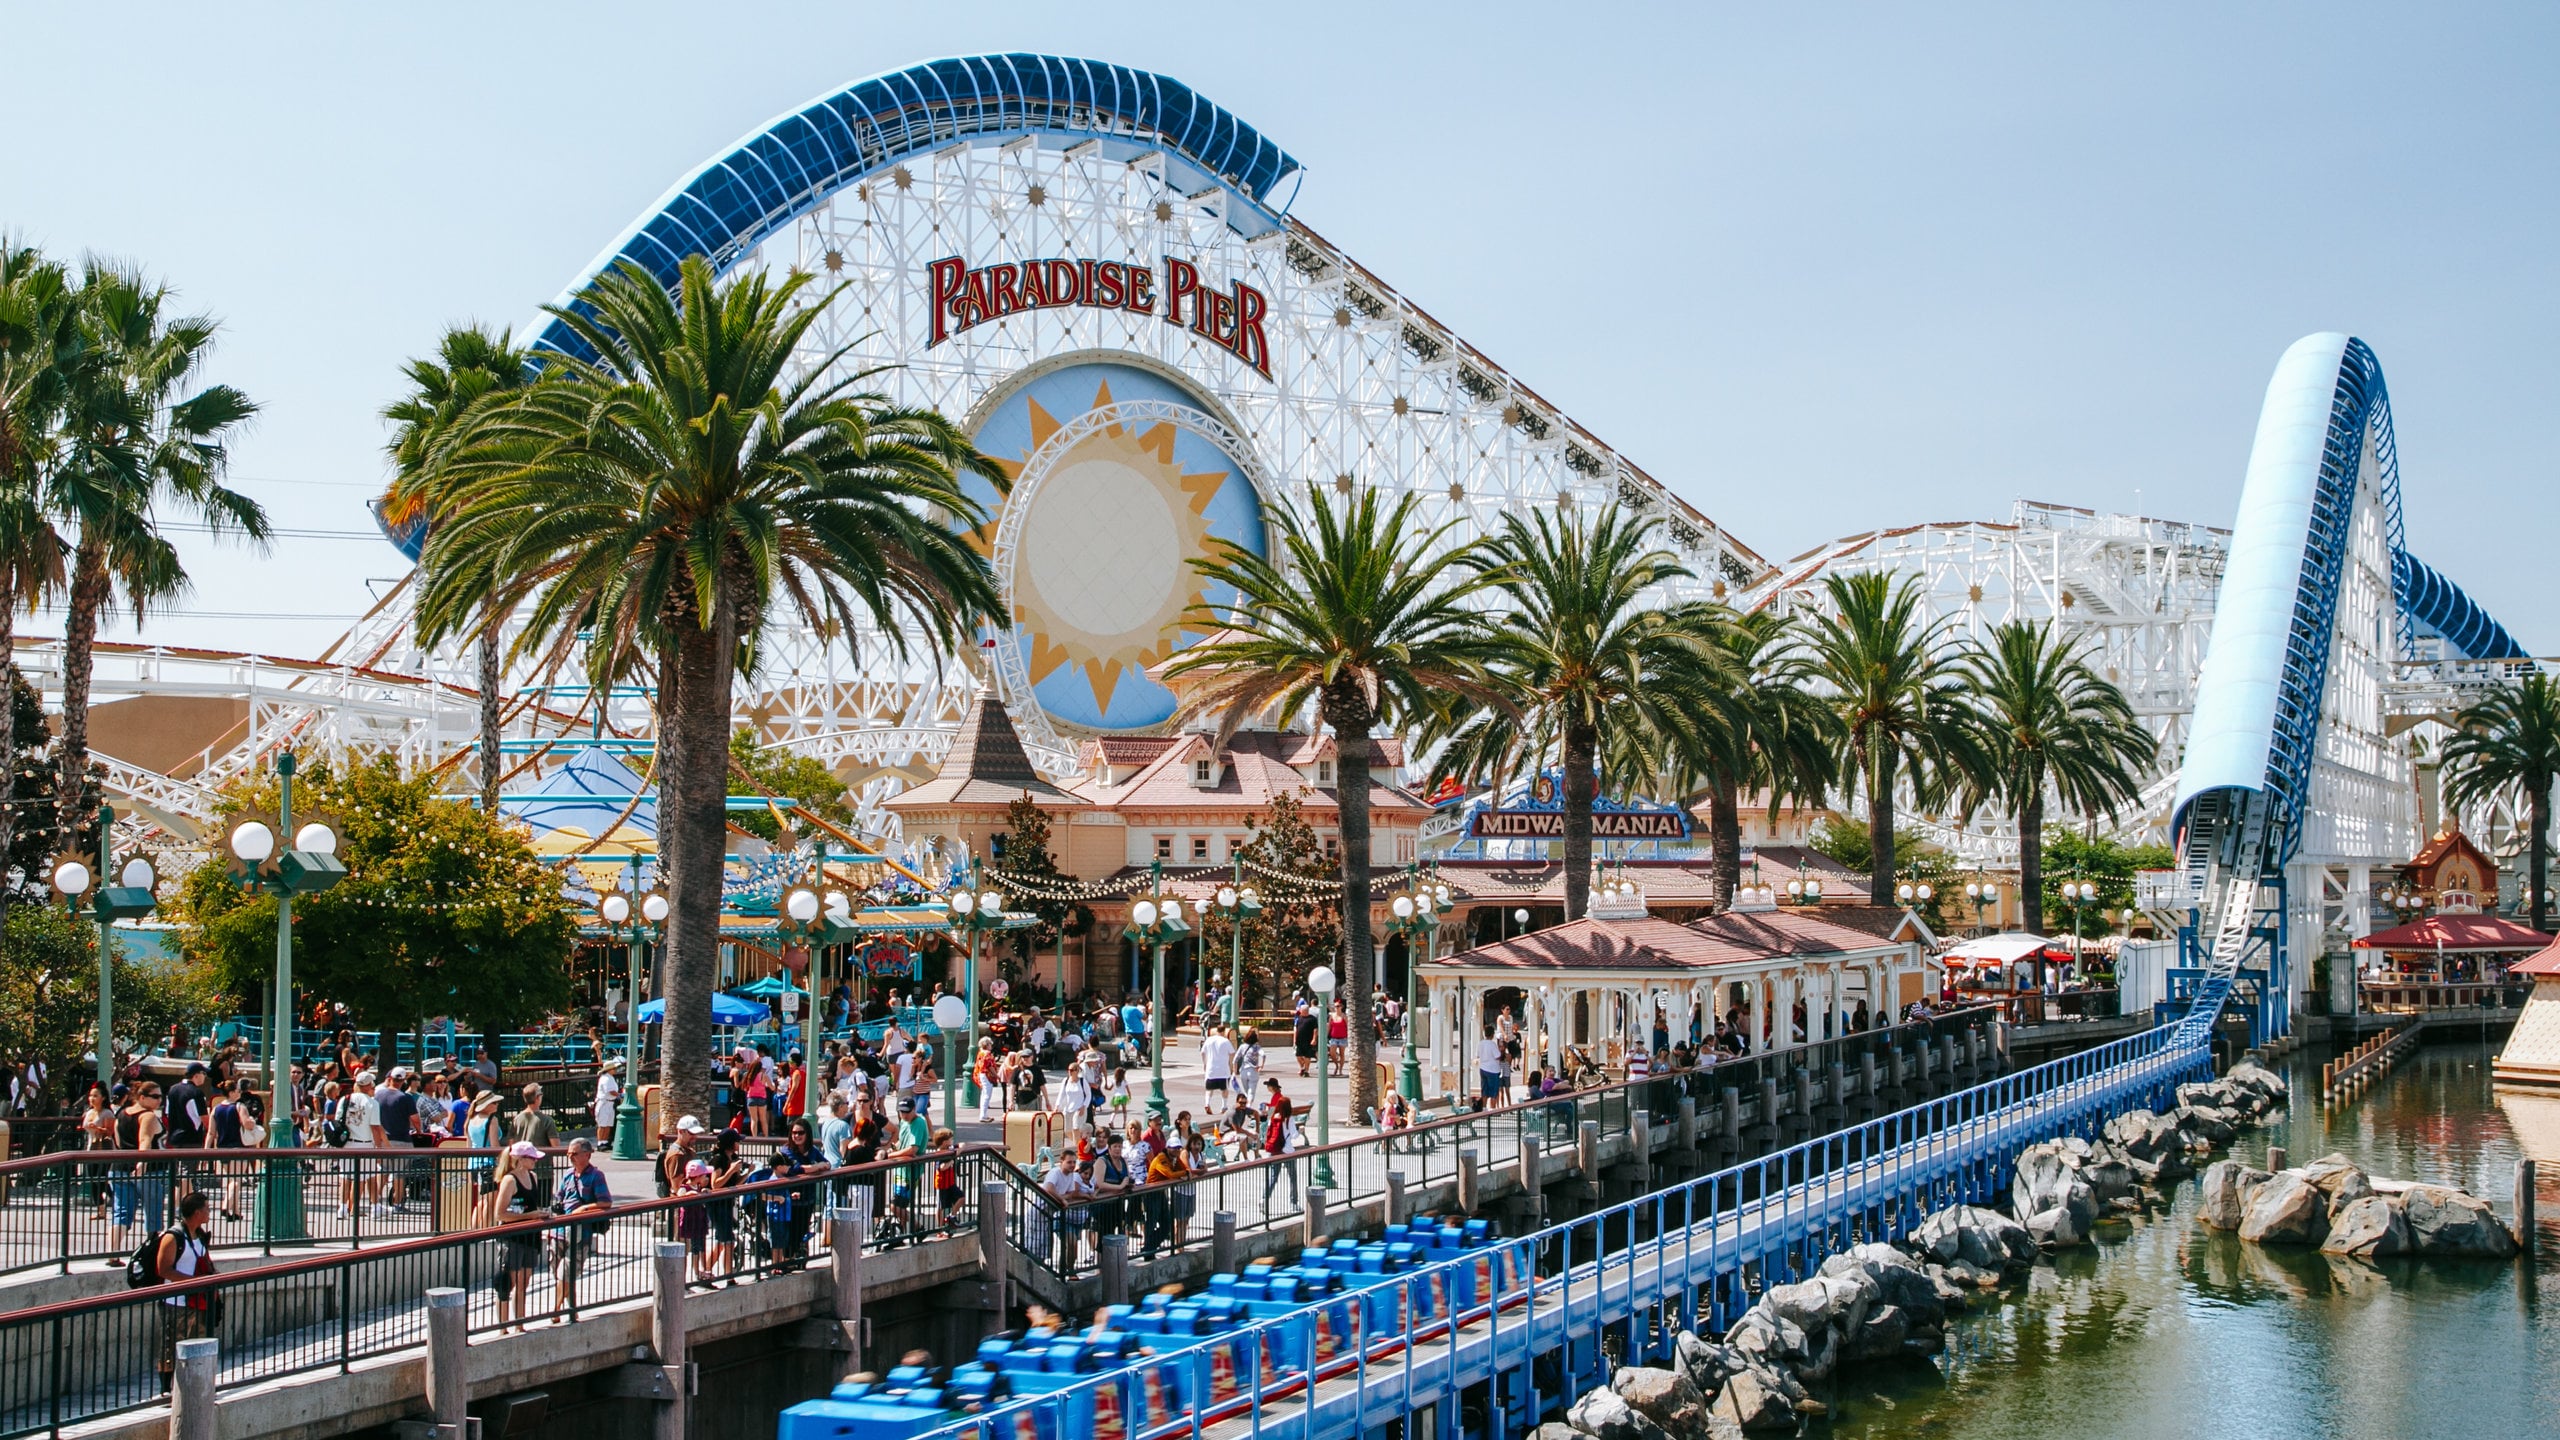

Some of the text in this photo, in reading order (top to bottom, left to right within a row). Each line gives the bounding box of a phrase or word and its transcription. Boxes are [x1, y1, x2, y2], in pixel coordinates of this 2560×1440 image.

[926, 255, 1273, 383] PARADISE PIER
[1481, 814, 1678, 835] MIDWA MANIA!
